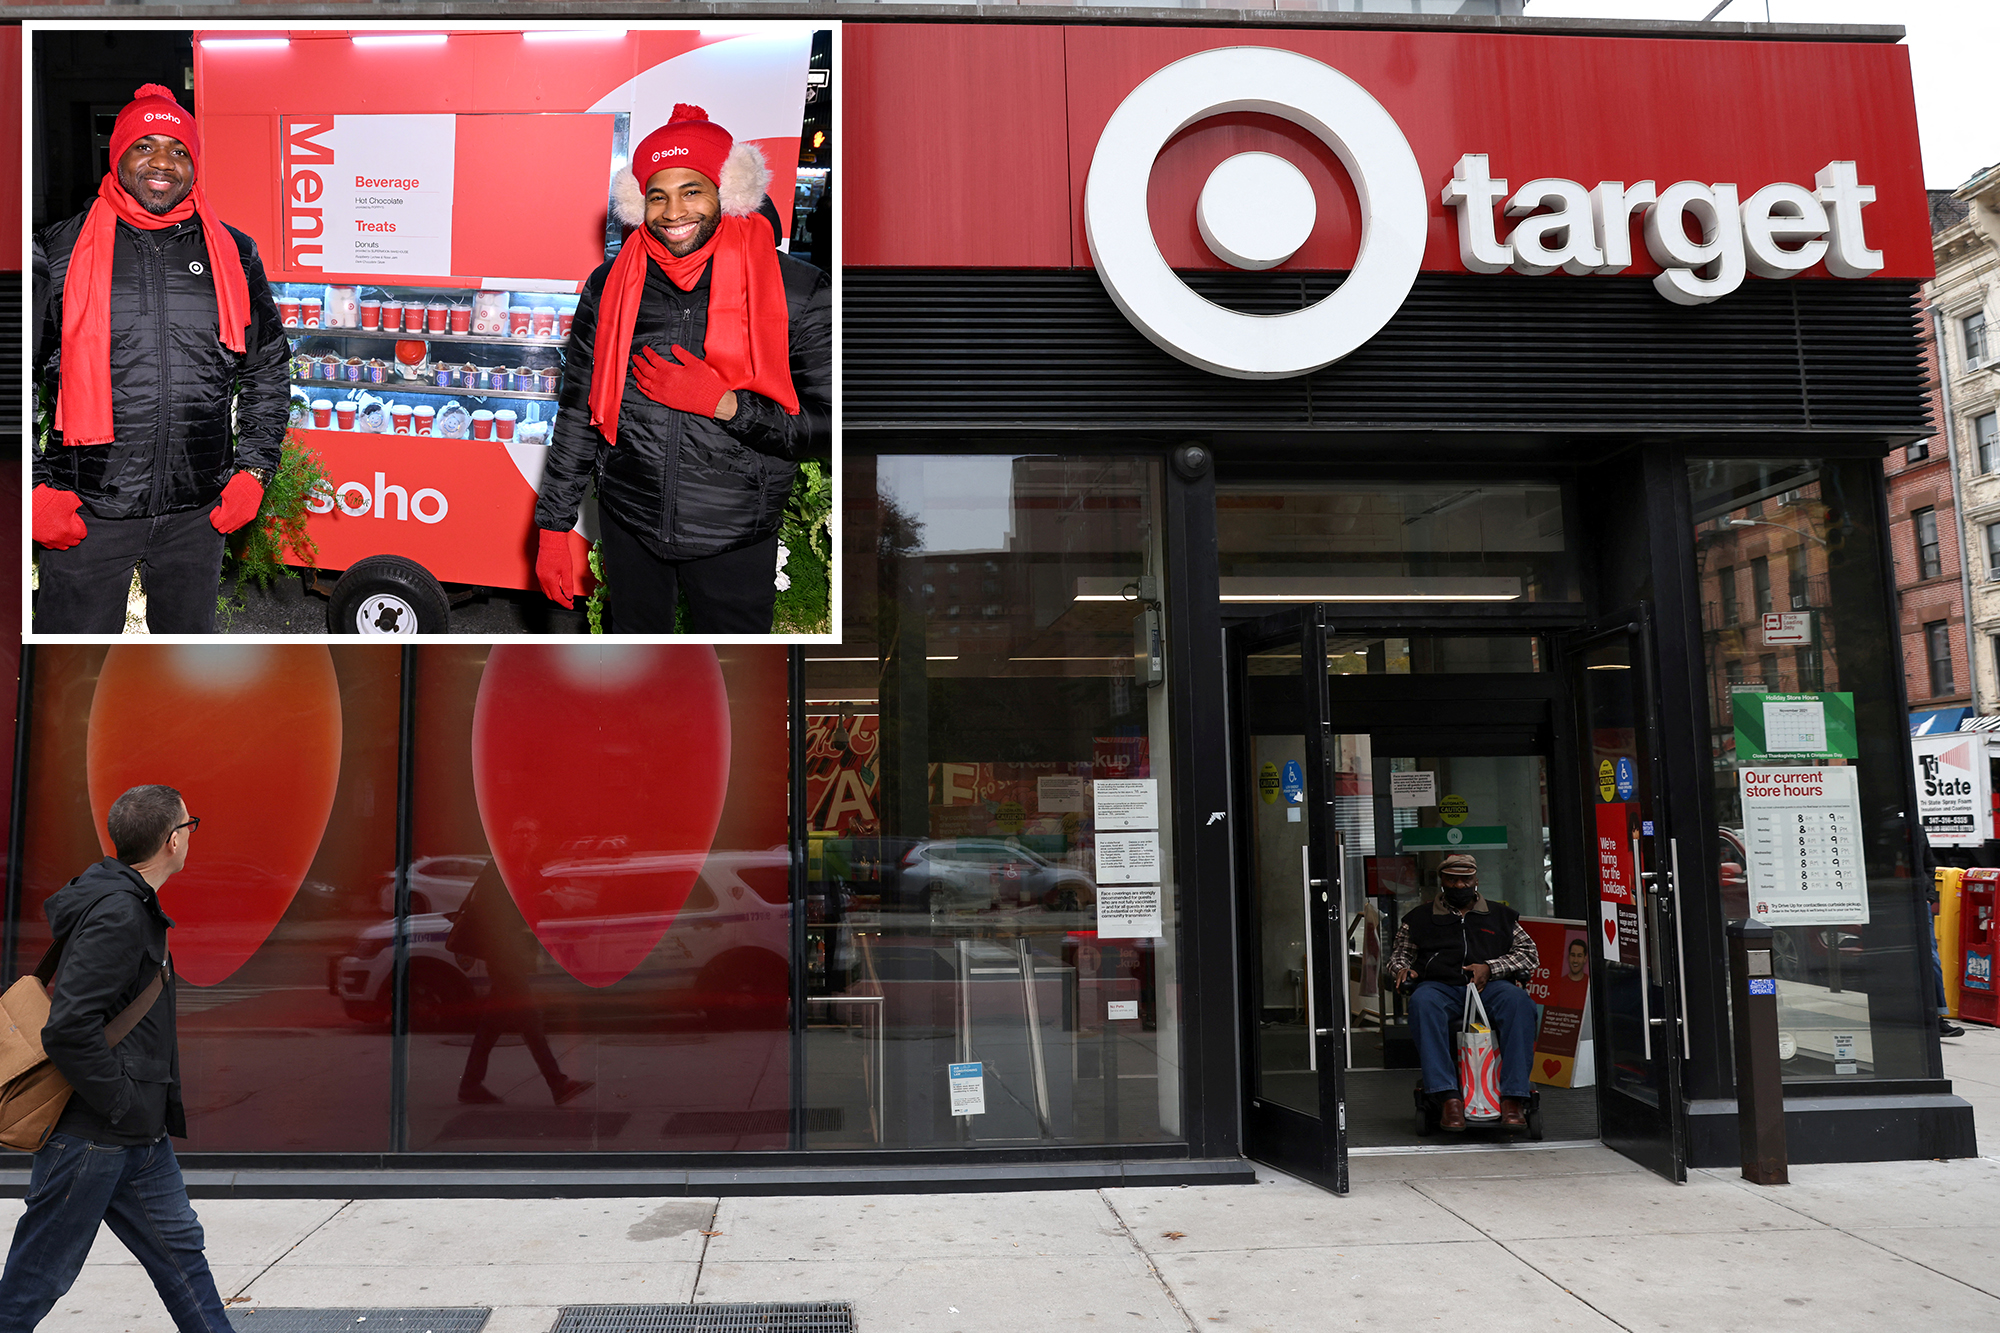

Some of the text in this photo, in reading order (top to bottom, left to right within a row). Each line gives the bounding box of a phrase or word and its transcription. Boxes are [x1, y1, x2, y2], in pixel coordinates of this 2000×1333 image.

[155, 113, 180, 124] soho
[661, 146, 689, 157] soho
[355, 176, 420, 190] Beverage
[290, 114, 335, 273] Menu
[355, 220, 396, 232] Treats
[1442, 154, 1884, 305] target
[304, 472, 448, 524] soho
[1745, 771, 1823, 784] Our current
[1746, 784, 1822, 797] store hours
[1925, 778, 1971, 796] State
[1798, 814, 1804, 823] 8
[1829, 813, 1836, 822] 9
[1799, 825, 1806, 834] 8
[1600, 837, 1616, 850] We're
[1799, 836, 1805, 846] 8
[1831, 836, 1838, 844] 9
[1800, 848, 1806, 856] 8
[1831, 847, 1838, 856] 9
[1601, 851, 1617, 868] hiring
[1801, 859, 1807, 868] 8
[1832, 858, 1839, 867] 9
[1602, 866, 1620, 880] for the
[1801, 870, 1807, 879] 8
[1835, 870, 1842, 878] 9
[1603, 881, 1627, 897] holidays.
[1801, 882, 1808, 891] 8
[1836, 881, 1843, 890] 9
